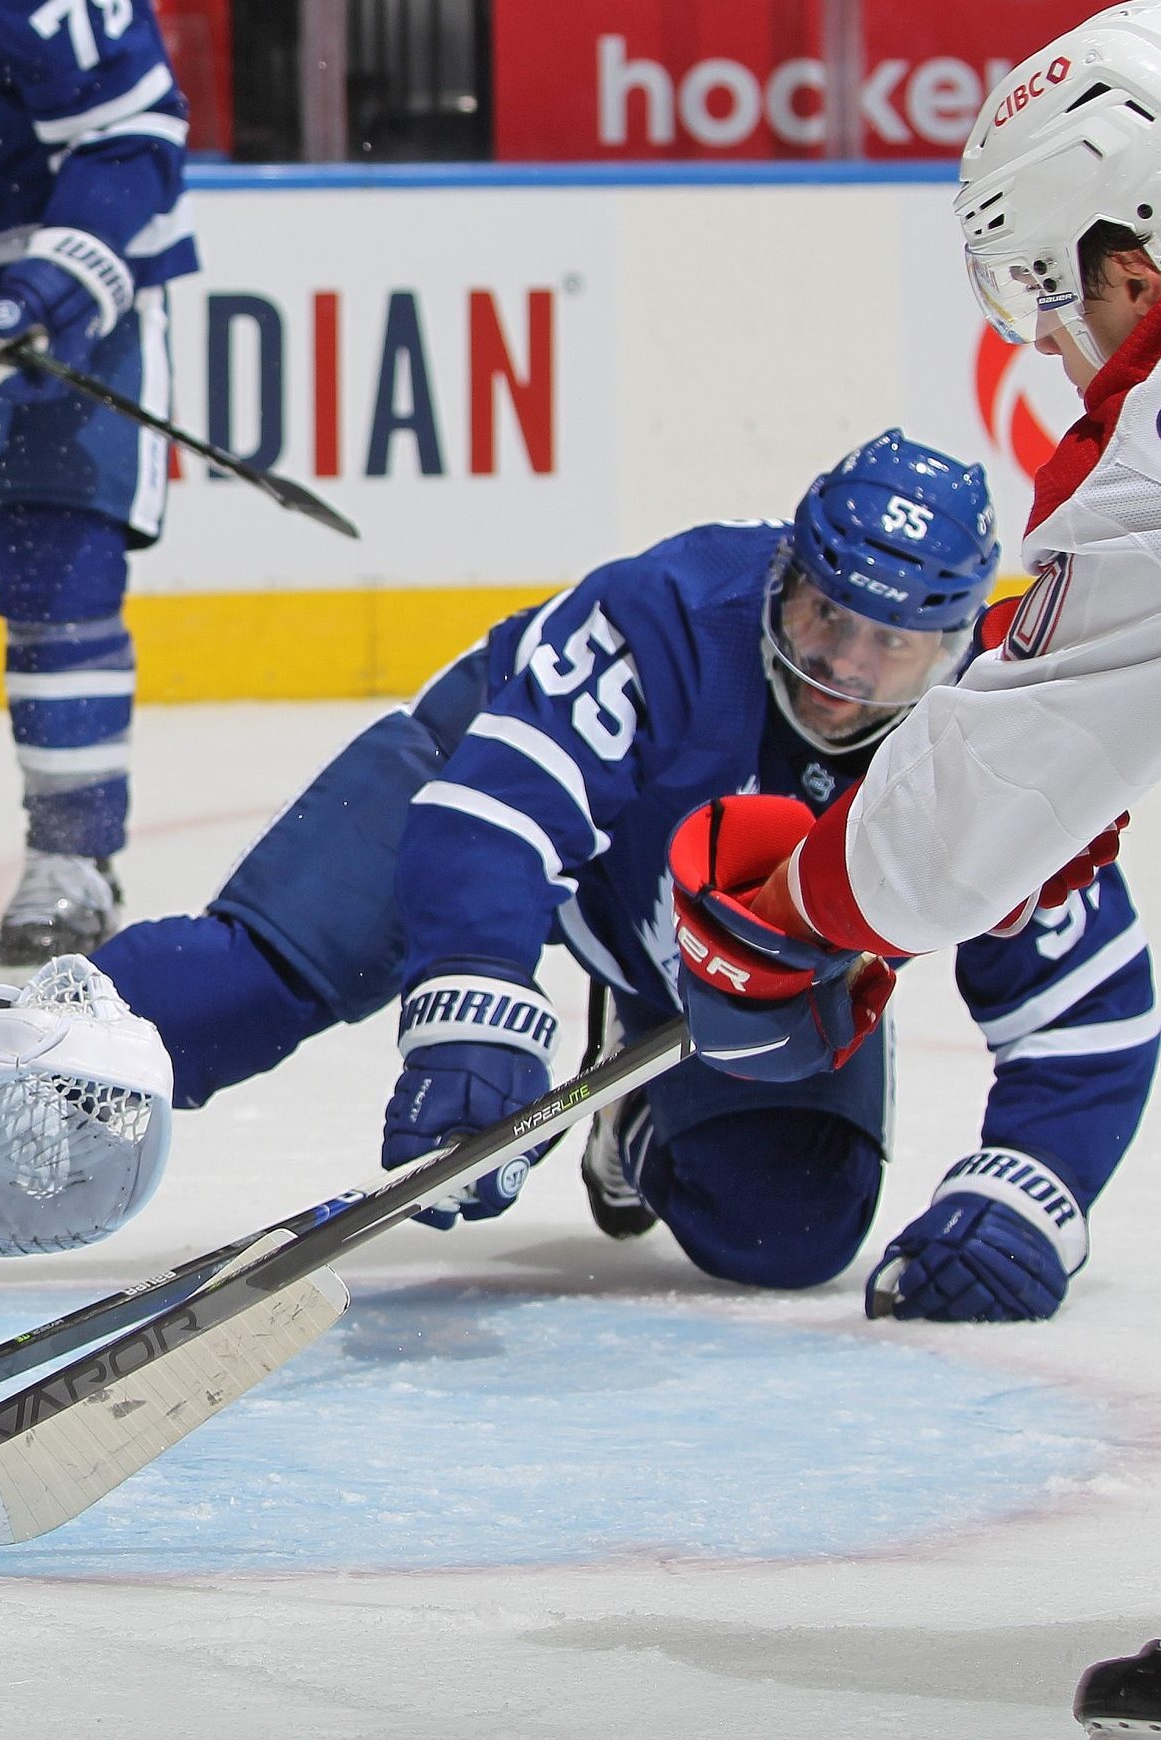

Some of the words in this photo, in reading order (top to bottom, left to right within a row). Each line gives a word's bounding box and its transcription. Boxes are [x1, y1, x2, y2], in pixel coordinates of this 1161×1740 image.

[994, 71, 1045, 127] CIBC
[167, 290, 555, 481] DIAN
[881, 494, 935, 541] 55
[848, 570, 911, 604] CCM
[528, 599, 640, 762] 55
[512, 1084, 591, 1137] HYPERLITE
[946, 1153, 1077, 1229] RRIOR
